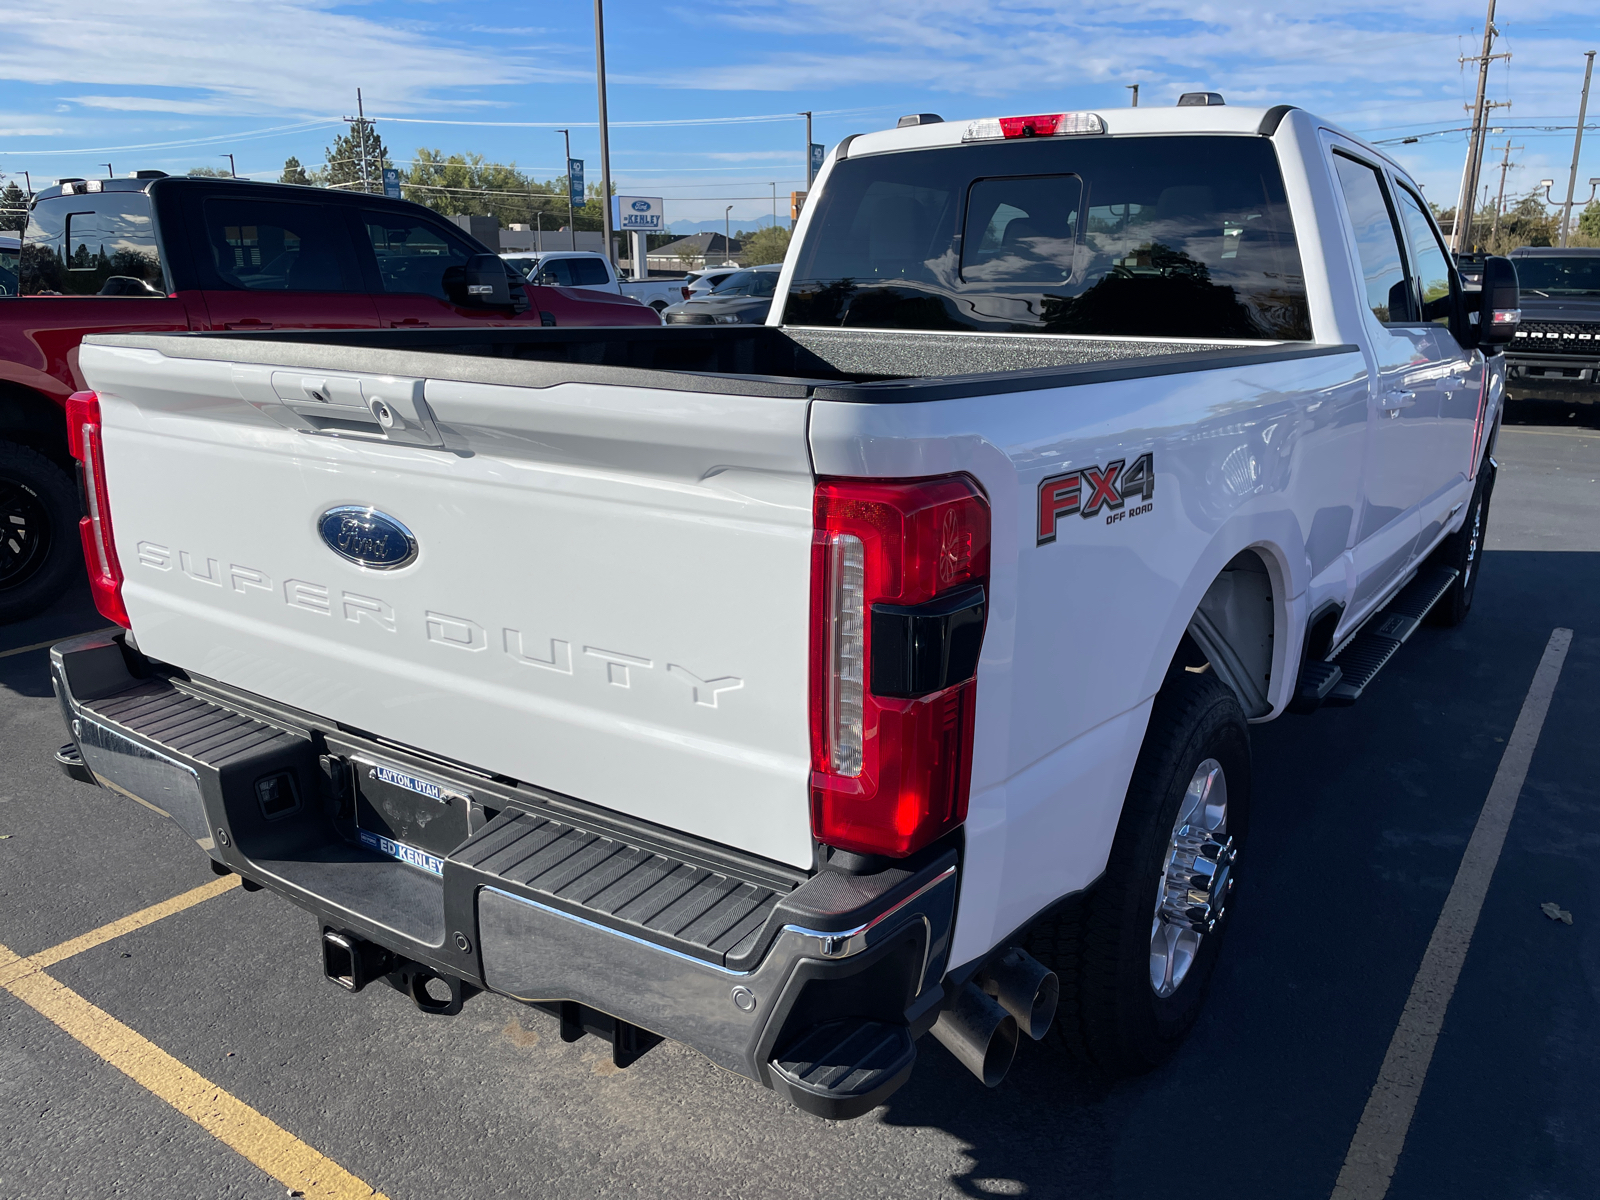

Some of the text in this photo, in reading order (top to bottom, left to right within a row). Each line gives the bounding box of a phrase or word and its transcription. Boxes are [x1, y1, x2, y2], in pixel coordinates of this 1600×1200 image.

[628, 214, 660, 227] KENLEY
[1036, 451, 1155, 548] FX4
[1106, 502, 1153, 525] OFF ROAD
[337, 517, 389, 558] Ford
[136, 540, 744, 709] SUPER DUTY
[377, 767, 439, 798] LAYTON, UTAH
[380, 839, 396, 855] ED
[399, 847, 444, 874] KENLEY
